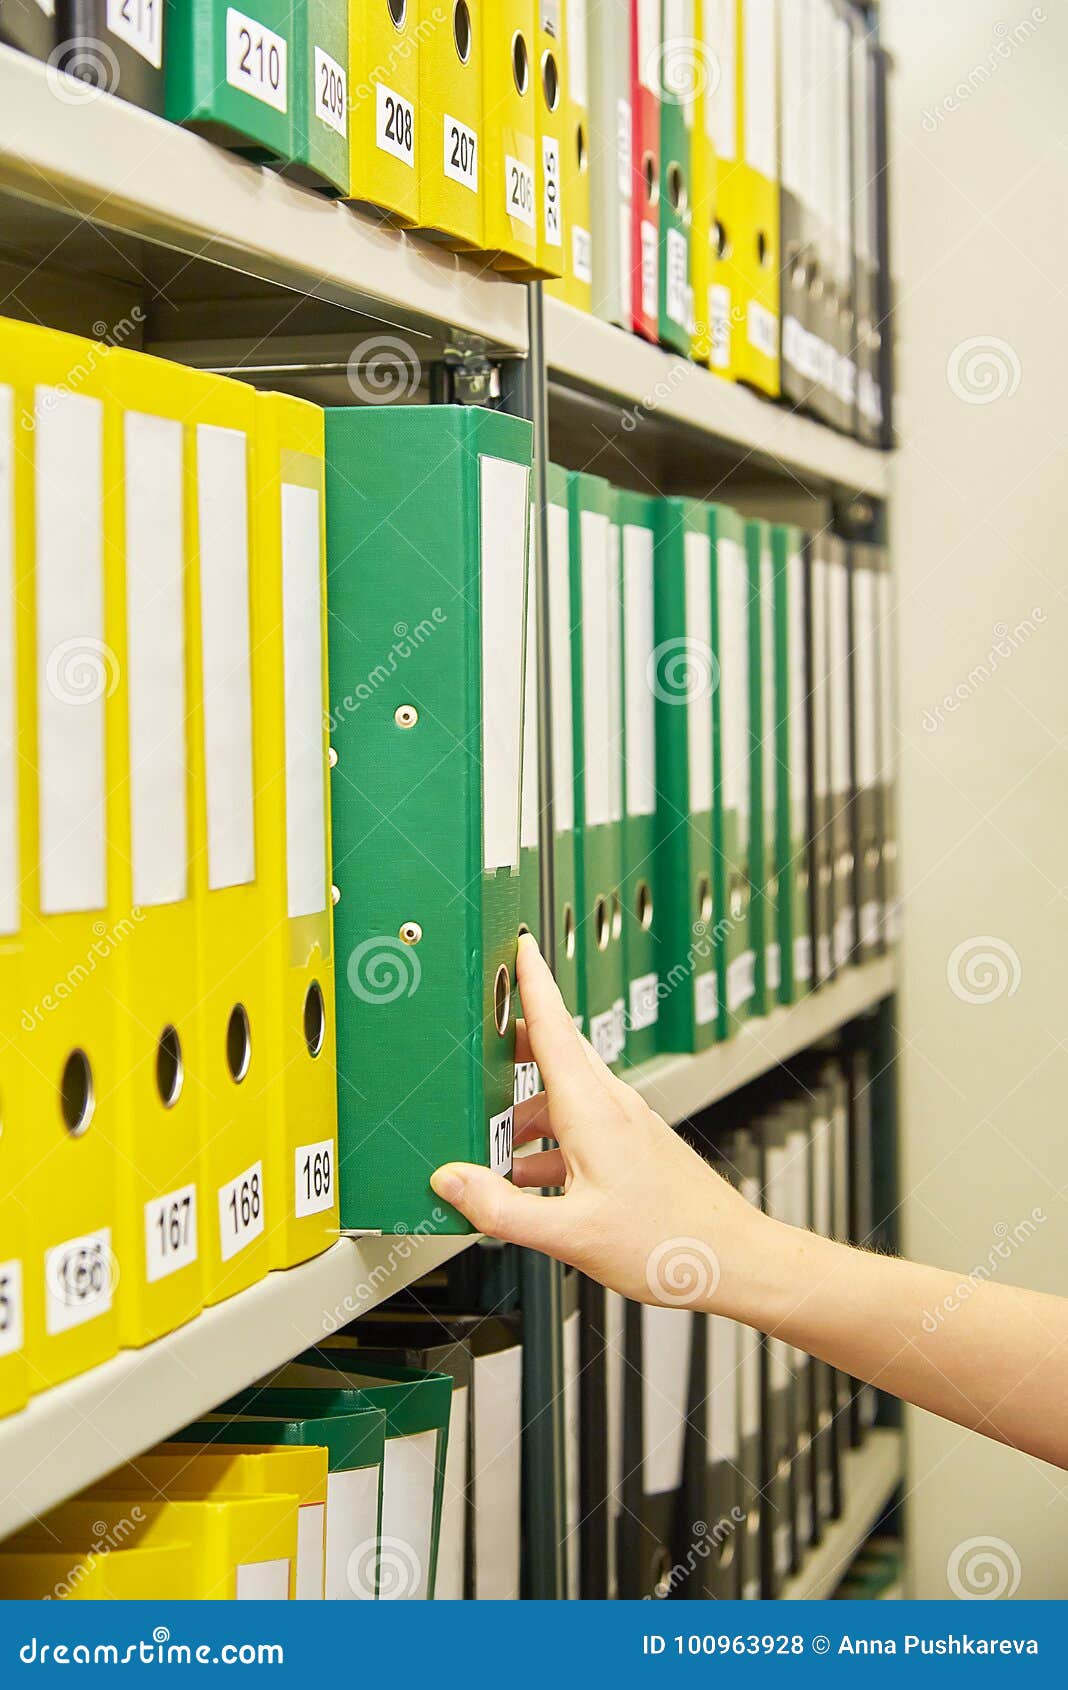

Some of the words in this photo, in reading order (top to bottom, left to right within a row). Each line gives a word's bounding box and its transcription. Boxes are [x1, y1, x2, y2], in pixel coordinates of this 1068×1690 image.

[239, 28, 280, 90] 210
[321, 63, 343, 119] 209
[385, 96, 412, 151] 208
[451, 127, 475, 176] 207
[511, 167, 533, 213] 206
[545, 152, 557, 231] 205
[514, 1062, 536, 1102] 173
[495, 1116, 511, 1166] 170
[303, 1150, 330, 1200] 169
[157, 1197, 190, 1256] 167
[229, 1173, 260, 1234] 168
[61, 1243, 102, 1307] 166
